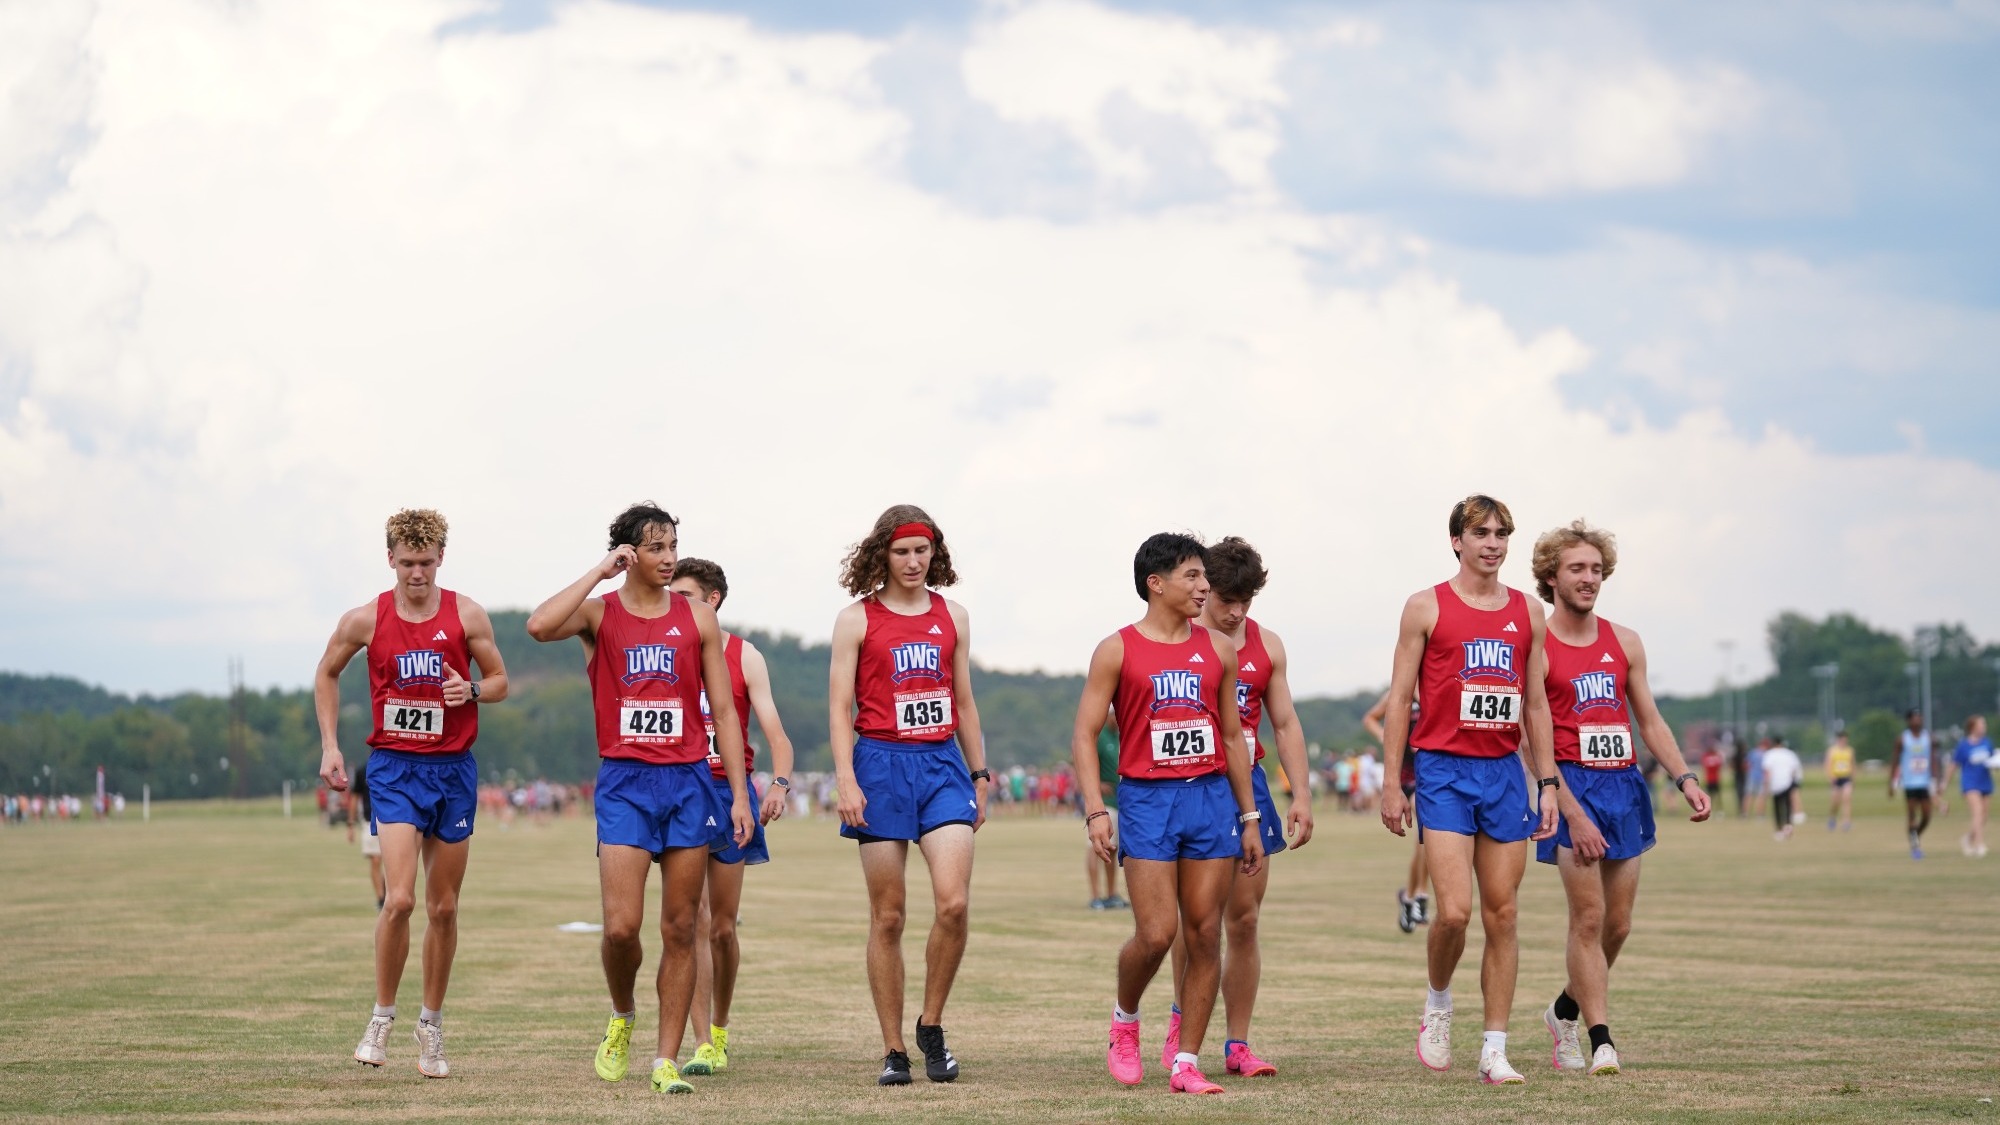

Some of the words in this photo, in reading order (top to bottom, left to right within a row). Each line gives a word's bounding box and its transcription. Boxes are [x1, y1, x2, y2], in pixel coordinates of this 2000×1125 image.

[399, 652, 440, 678] UWG
[628, 646, 671, 673] UWG
[895, 645, 937, 672] UWG
[1467, 641, 1510, 671] UWG
[896, 693, 918, 702] FOOTHILLS
[919, 691, 947, 699] INVITATIONAL
[1155, 673, 1197, 700] UWG
[1464, 684, 1488, 692] FOOTHILLS
[1575, 674, 1614, 702] UWG
[388, 698, 410, 706] FOOTHILLS
[904, 701, 943, 726] 435
[1470, 695, 1511, 720] 434
[395, 708, 432, 731] 421
[630, 710, 673, 734] 428
[1153, 722, 1178, 730] FOOTHILLS
[1179, 718, 1209, 727] INVITATIONAL
[1162, 730, 1205, 756] 425
[1588, 735, 1624, 758] 438
